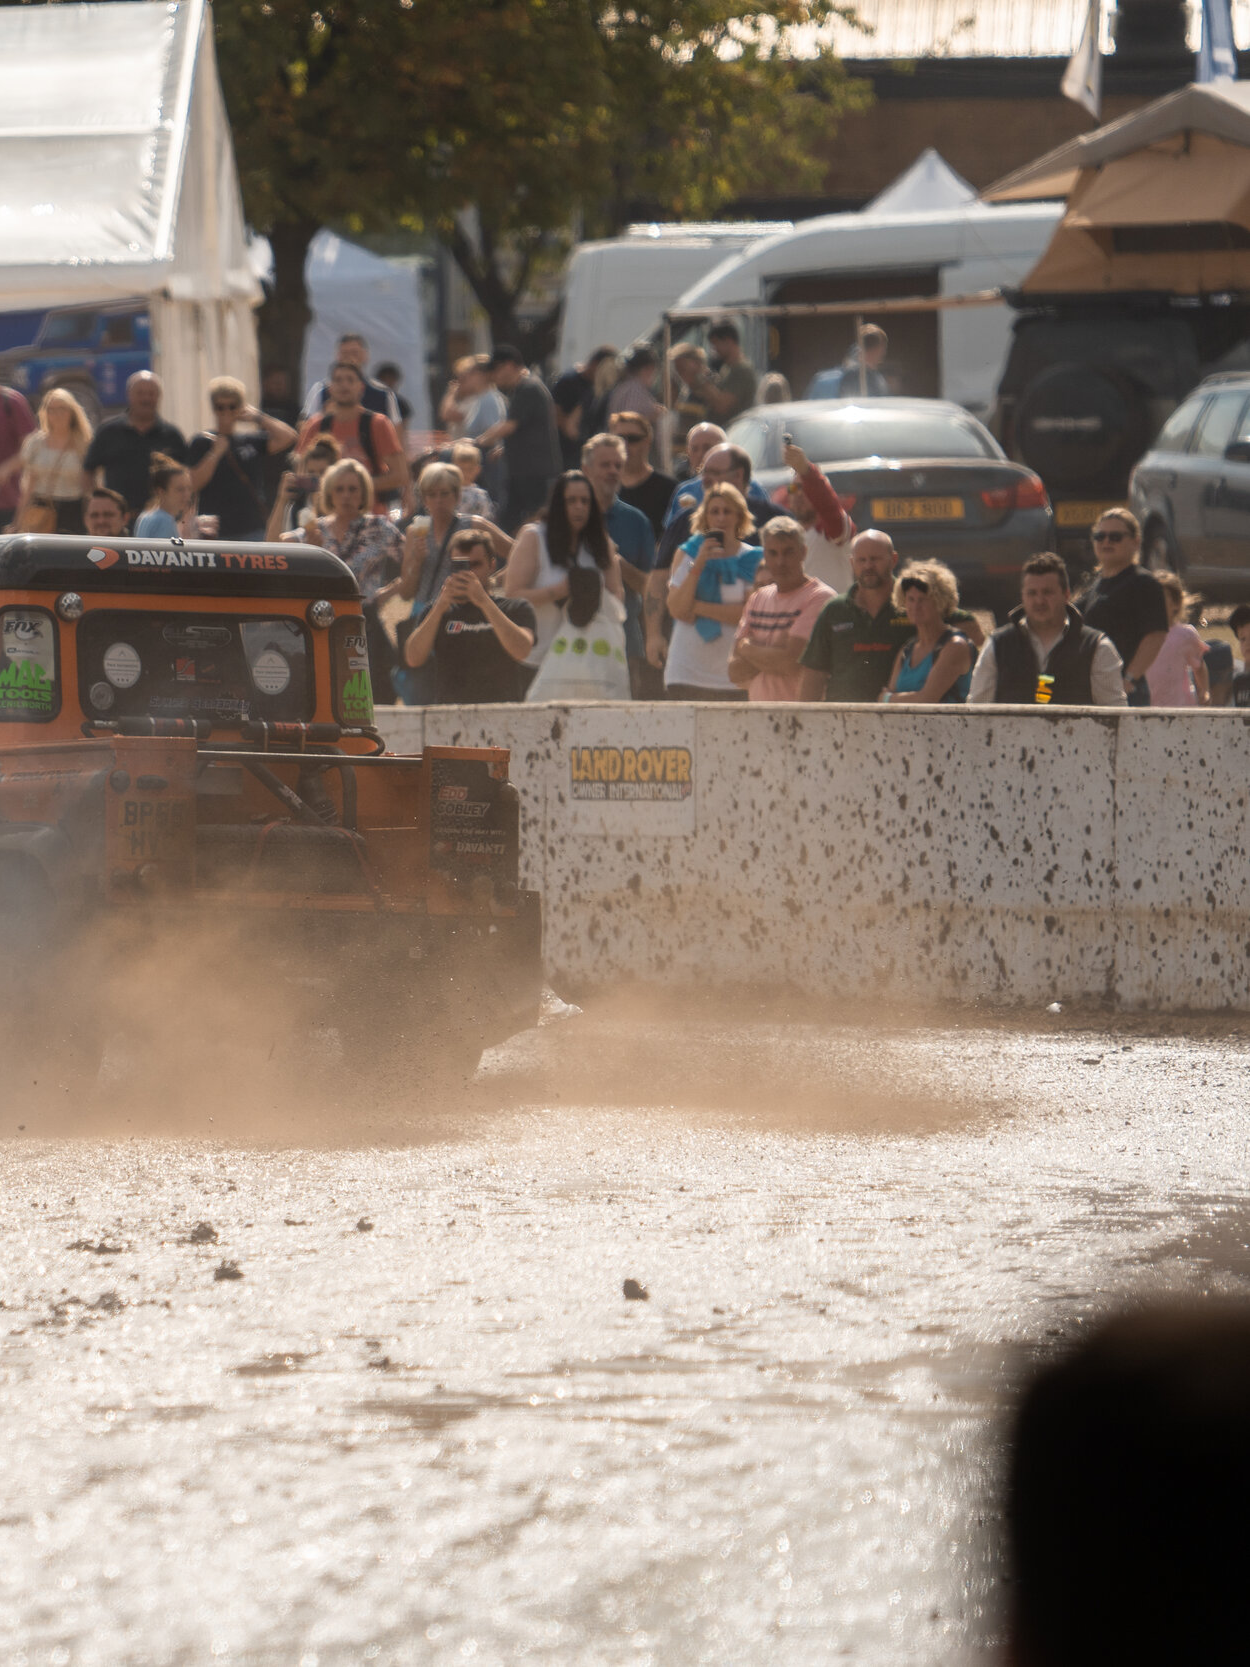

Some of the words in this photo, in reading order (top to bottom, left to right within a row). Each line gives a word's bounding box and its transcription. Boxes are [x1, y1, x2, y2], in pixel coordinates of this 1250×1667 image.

[125, 550, 217, 568] DAVANTI
[220, 553, 289, 570] TYRES
[571, 747, 622, 781] LAND
[623, 747, 692, 781] ROVER
[438, 786, 468, 800] EDD
[436, 801, 490, 817] COBLEY
[455, 842, 506, 854] DAVANTI
